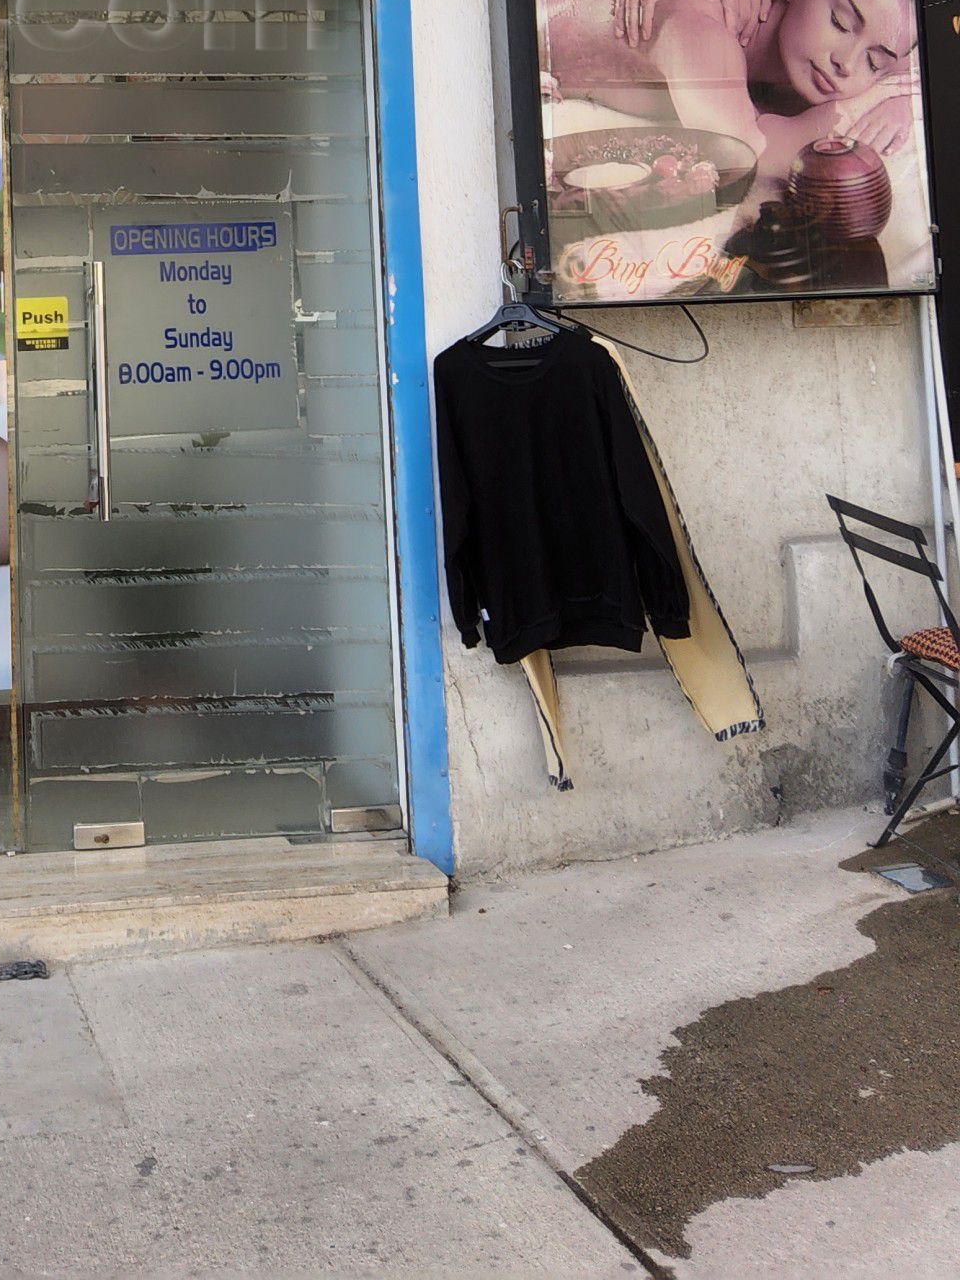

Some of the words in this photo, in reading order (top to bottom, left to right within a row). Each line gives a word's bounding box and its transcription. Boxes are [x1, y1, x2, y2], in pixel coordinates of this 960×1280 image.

[113, 227, 201, 250] OPENING
[207, 225, 276, 247] HOURS
[160, 260, 232, 285] Monday
[558, 239, 654, 295] Bing
[656, 236, 748, 293] Bing
[188, 294, 207, 314] to
[22, 310, 64, 325] Push
[164, 327, 233, 352] Sunday
[210, 359, 281, 384] 9.00pm
